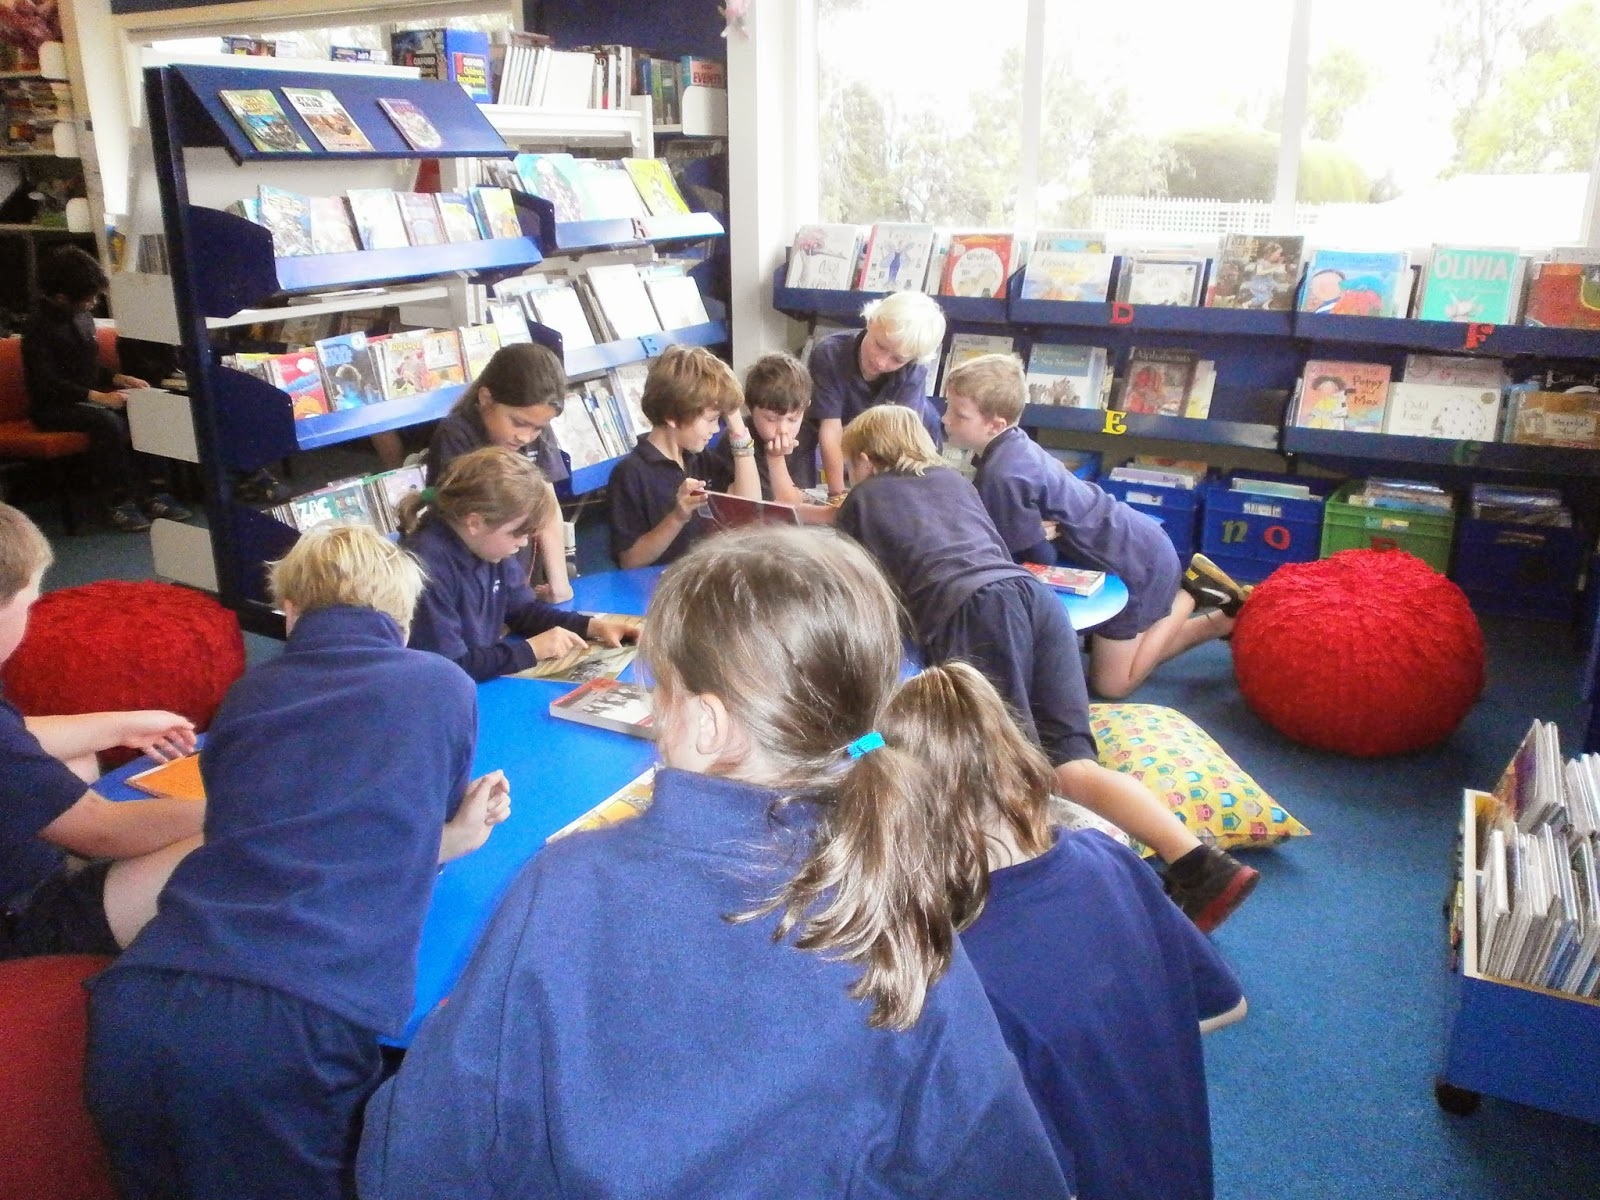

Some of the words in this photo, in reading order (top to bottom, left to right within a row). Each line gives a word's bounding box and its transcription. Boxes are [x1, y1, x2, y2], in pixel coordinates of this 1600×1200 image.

[1434, 254, 1509, 280] OLIVIA
[1109, 301, 1134, 325] D
[1465, 322, 1494, 349] F
[1352, 374, 1385, 390] Poppy
[1354, 395, 1379, 406] Max
[1102, 410, 1128, 435] E
[1222, 520, 1248, 543] n
